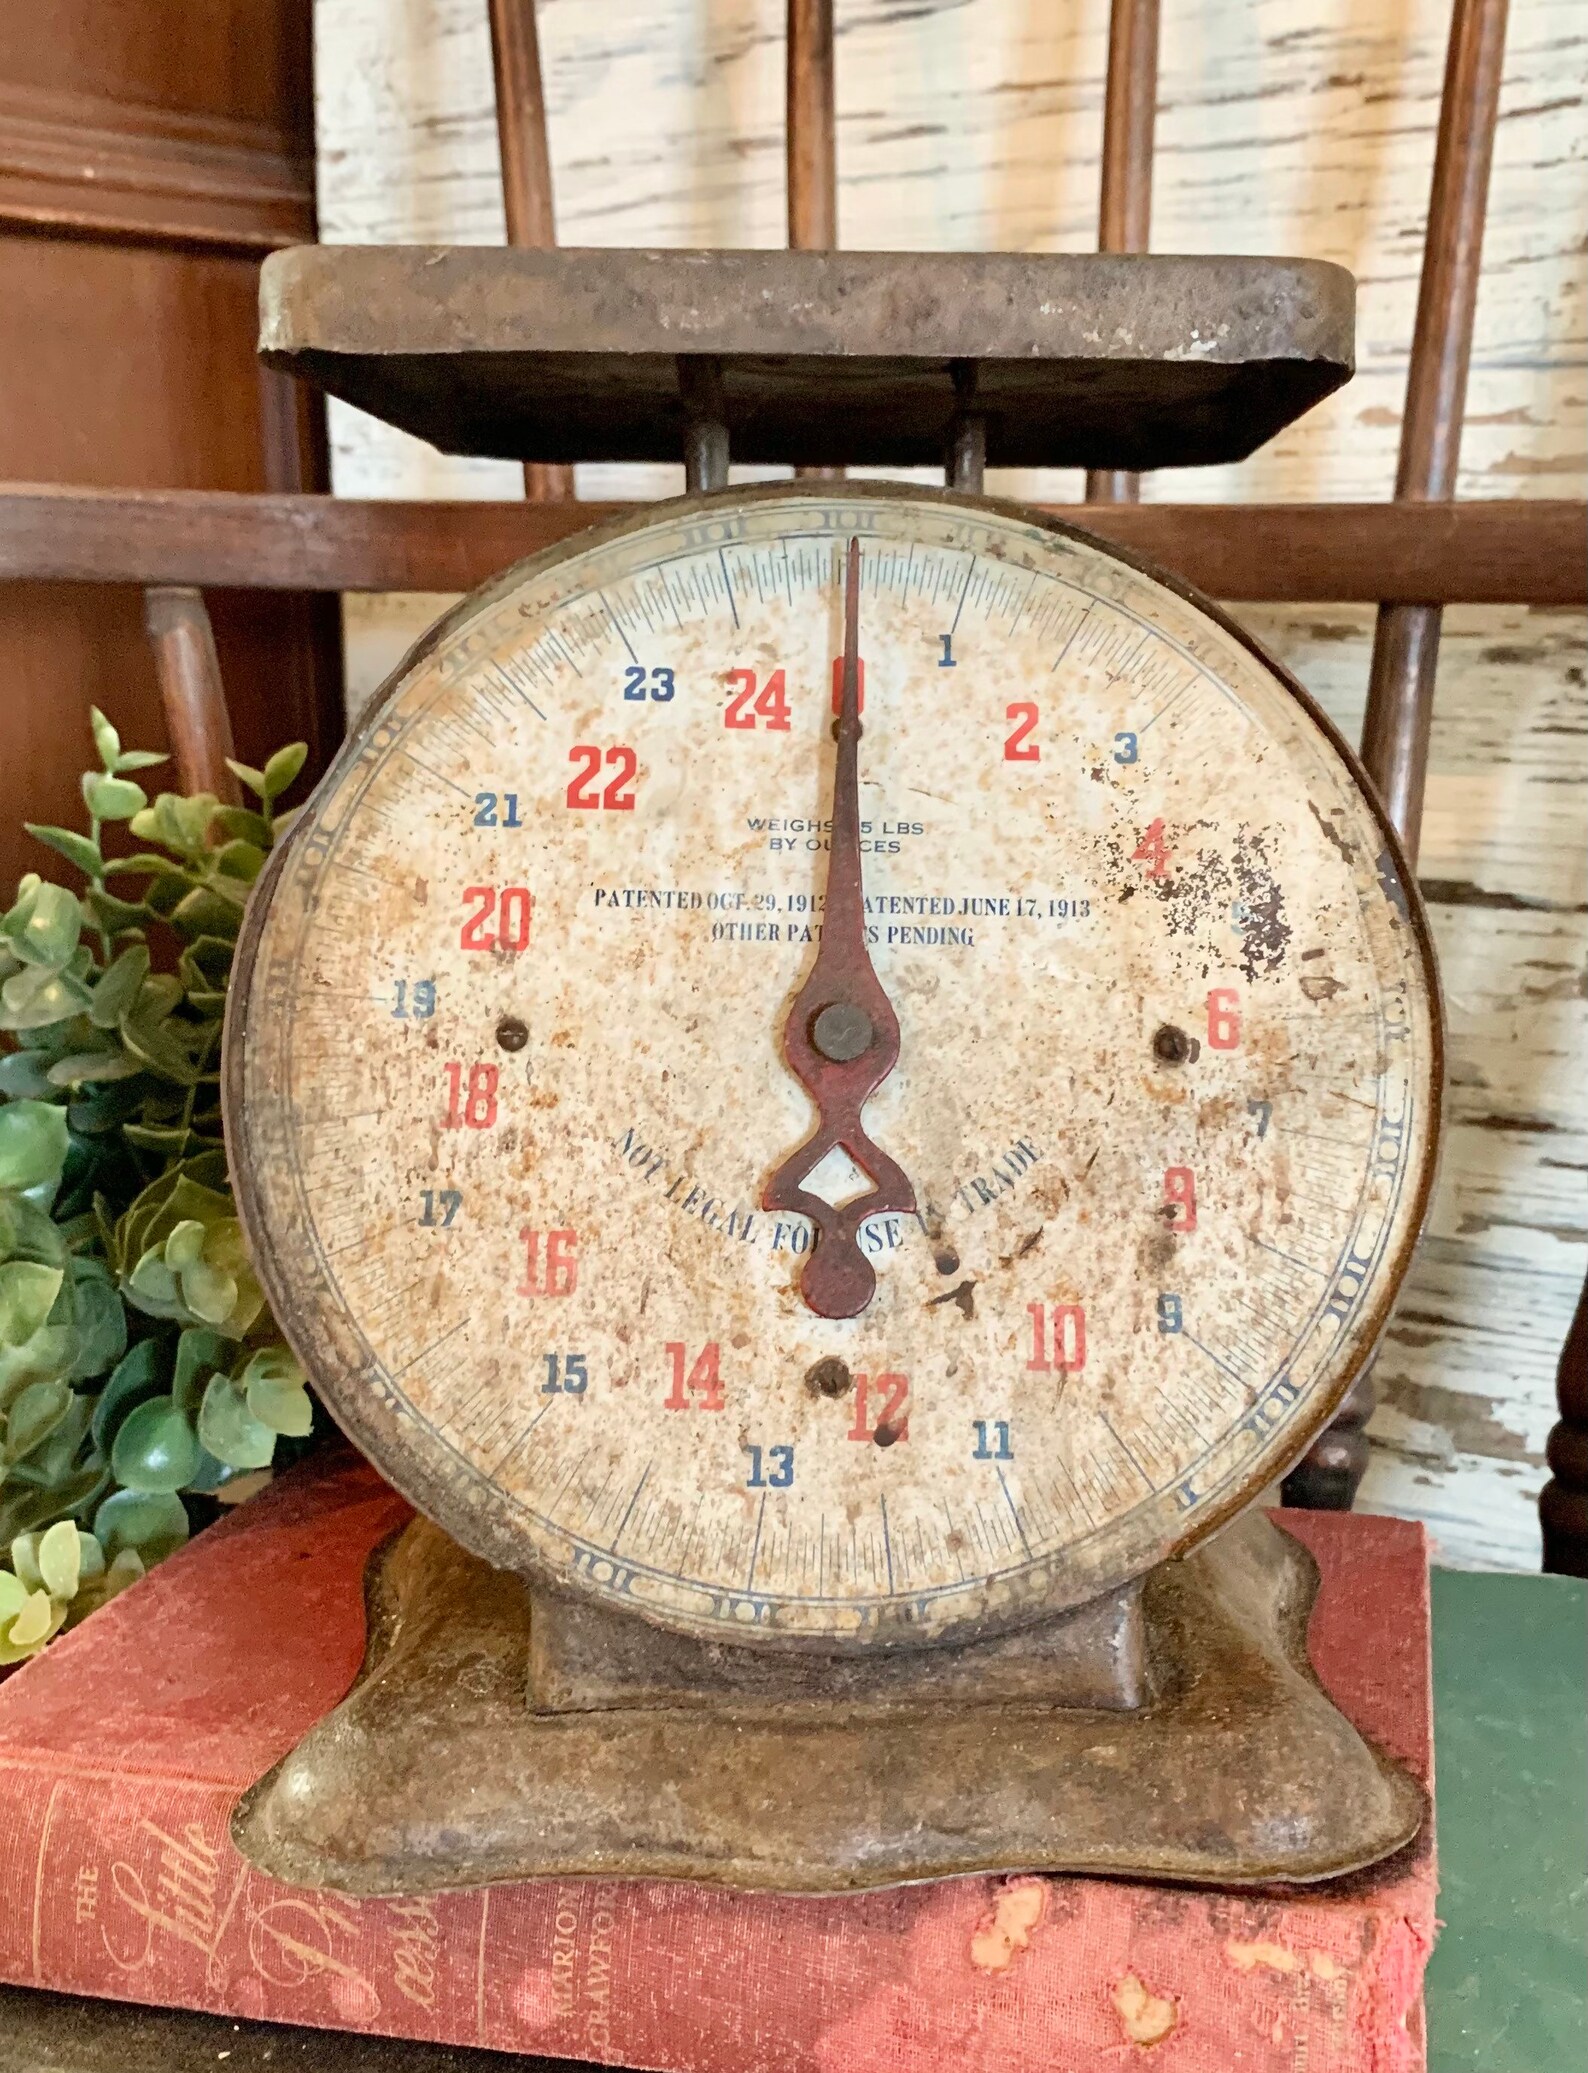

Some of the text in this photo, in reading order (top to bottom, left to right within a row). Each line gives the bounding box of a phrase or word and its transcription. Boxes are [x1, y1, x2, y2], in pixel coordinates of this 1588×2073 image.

[938, 634, 957, 667] 1
[625, 667, 676, 702] 23
[724, 669, 792, 731] 24
[1004, 702, 1040, 762] 2
[1114, 733, 1138, 764] 3
[566, 745, 638, 811] 22
[475, 792, 523, 828] 21
[746, 818, 833, 833] WEIGHS
[882, 822, 925, 836] LBS
[769, 837, 901, 854] BY OUCES
[1130, 817, 1172, 880] 4
[461, 886, 534, 952] 20
[594, 888, 701, 910] PATENTED
[862, 895, 955, 916] ATENTED
[958, 898, 1011, 917] JUNE
[1016, 899, 1042, 919] 17,
[1048, 899, 1091, 918] 1913
[712, 922, 975, 948] OTHER PATS PENDING
[390, 978, 437, 1019] 19
[1206, 988, 1241, 1051] 6
[439, 1062, 499, 1130] 18
[1248, 1099, 1274, 1142] 7
[418, 1190, 463, 1227] 17
[617, 1126, 668, 1183] NOT
[663, 1176, 758, 1244] LEGAL
[858, 1217, 904, 1253] SE
[951, 1135, 1045, 1214] TRADE
[516, 1225, 578, 1298] 16
[1028, 1303, 1087, 1372] 10
[1157, 1293, 1183, 1334] 9
[541, 1353, 588, 1393] 15
[664, 1342, 725, 1411] 14
[847, 1373, 909, 1442] 12
[746, 1446, 795, 1489] 13
[973, 1421, 1014, 1461] 11
[76, 1864, 98, 1925] THE
[100, 1818, 240, 1993] Little
[552, 1886, 579, 2019] MARION
[588, 1882, 619, 2047] CRAWFOR
